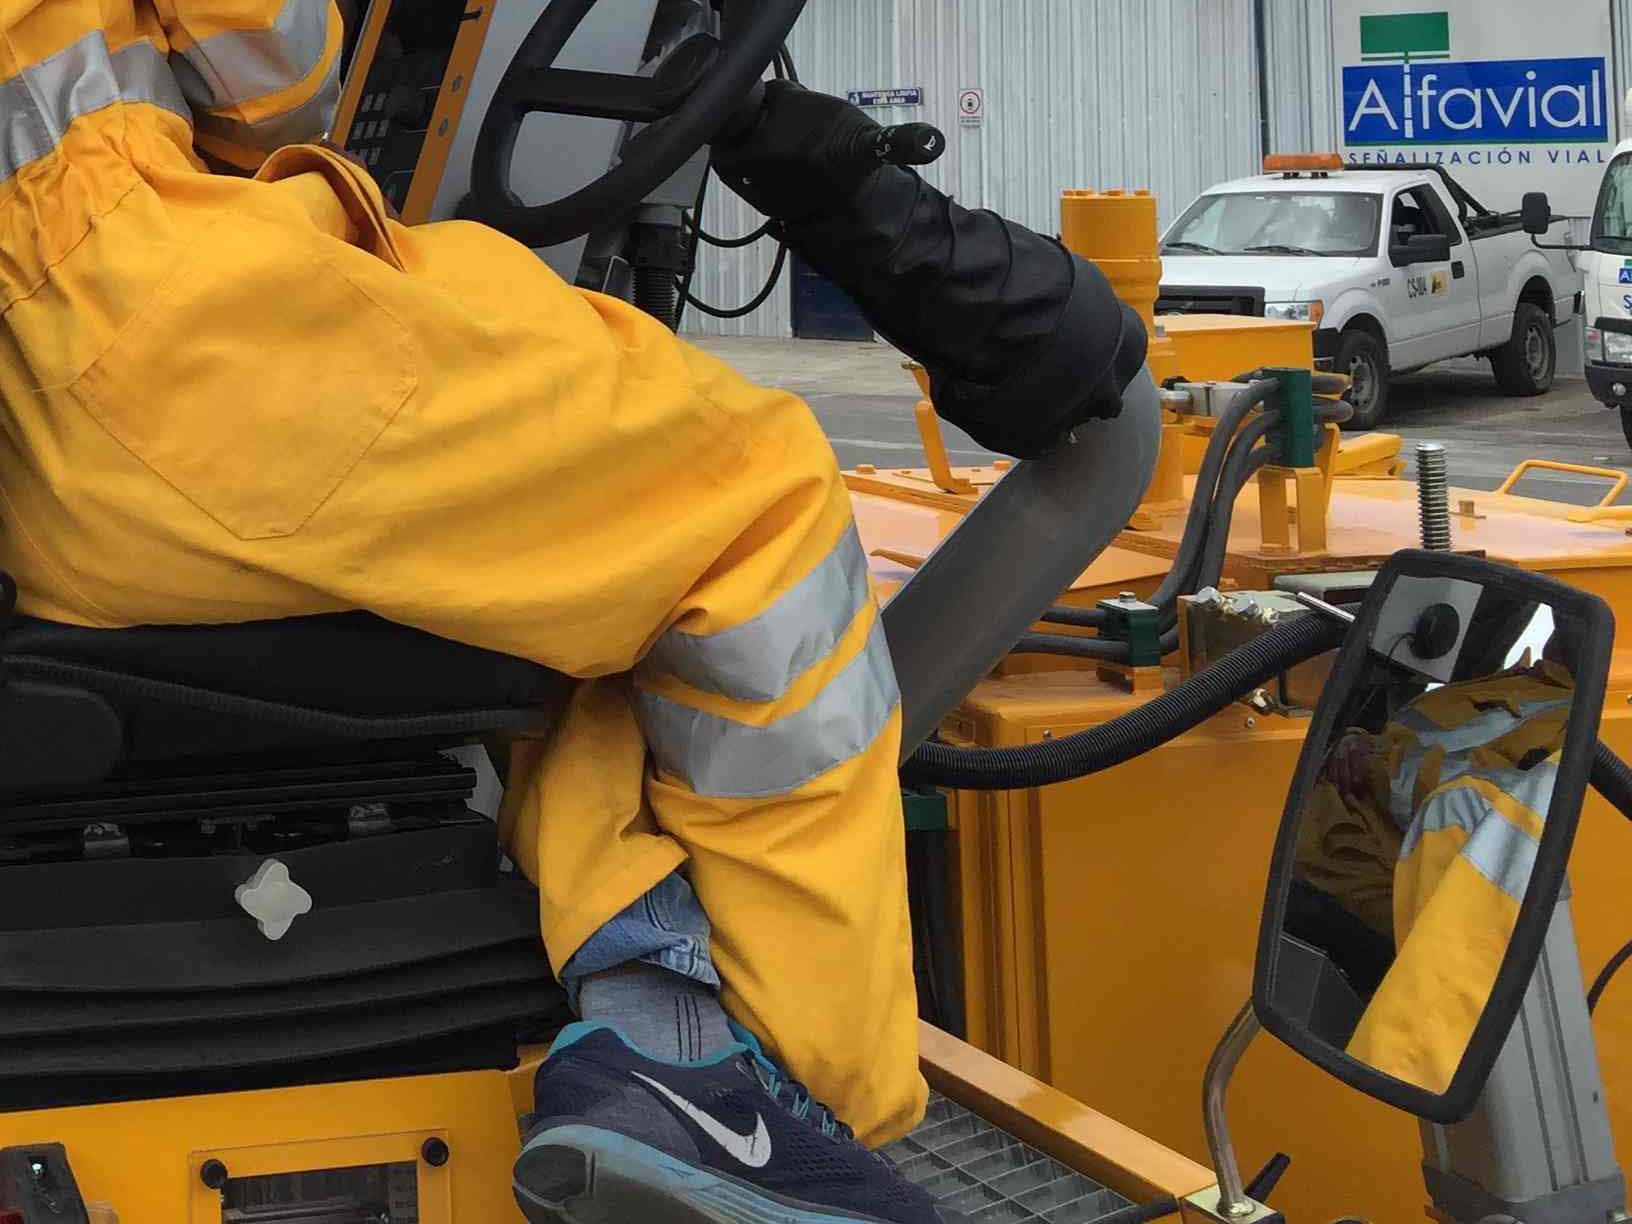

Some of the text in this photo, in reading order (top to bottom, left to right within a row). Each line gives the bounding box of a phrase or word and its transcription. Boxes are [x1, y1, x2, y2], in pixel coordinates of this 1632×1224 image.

[1348, 63, 1601, 138] Alfavial
[1349, 146, 1606, 164] SEÑALIZACIÓN VIAL
